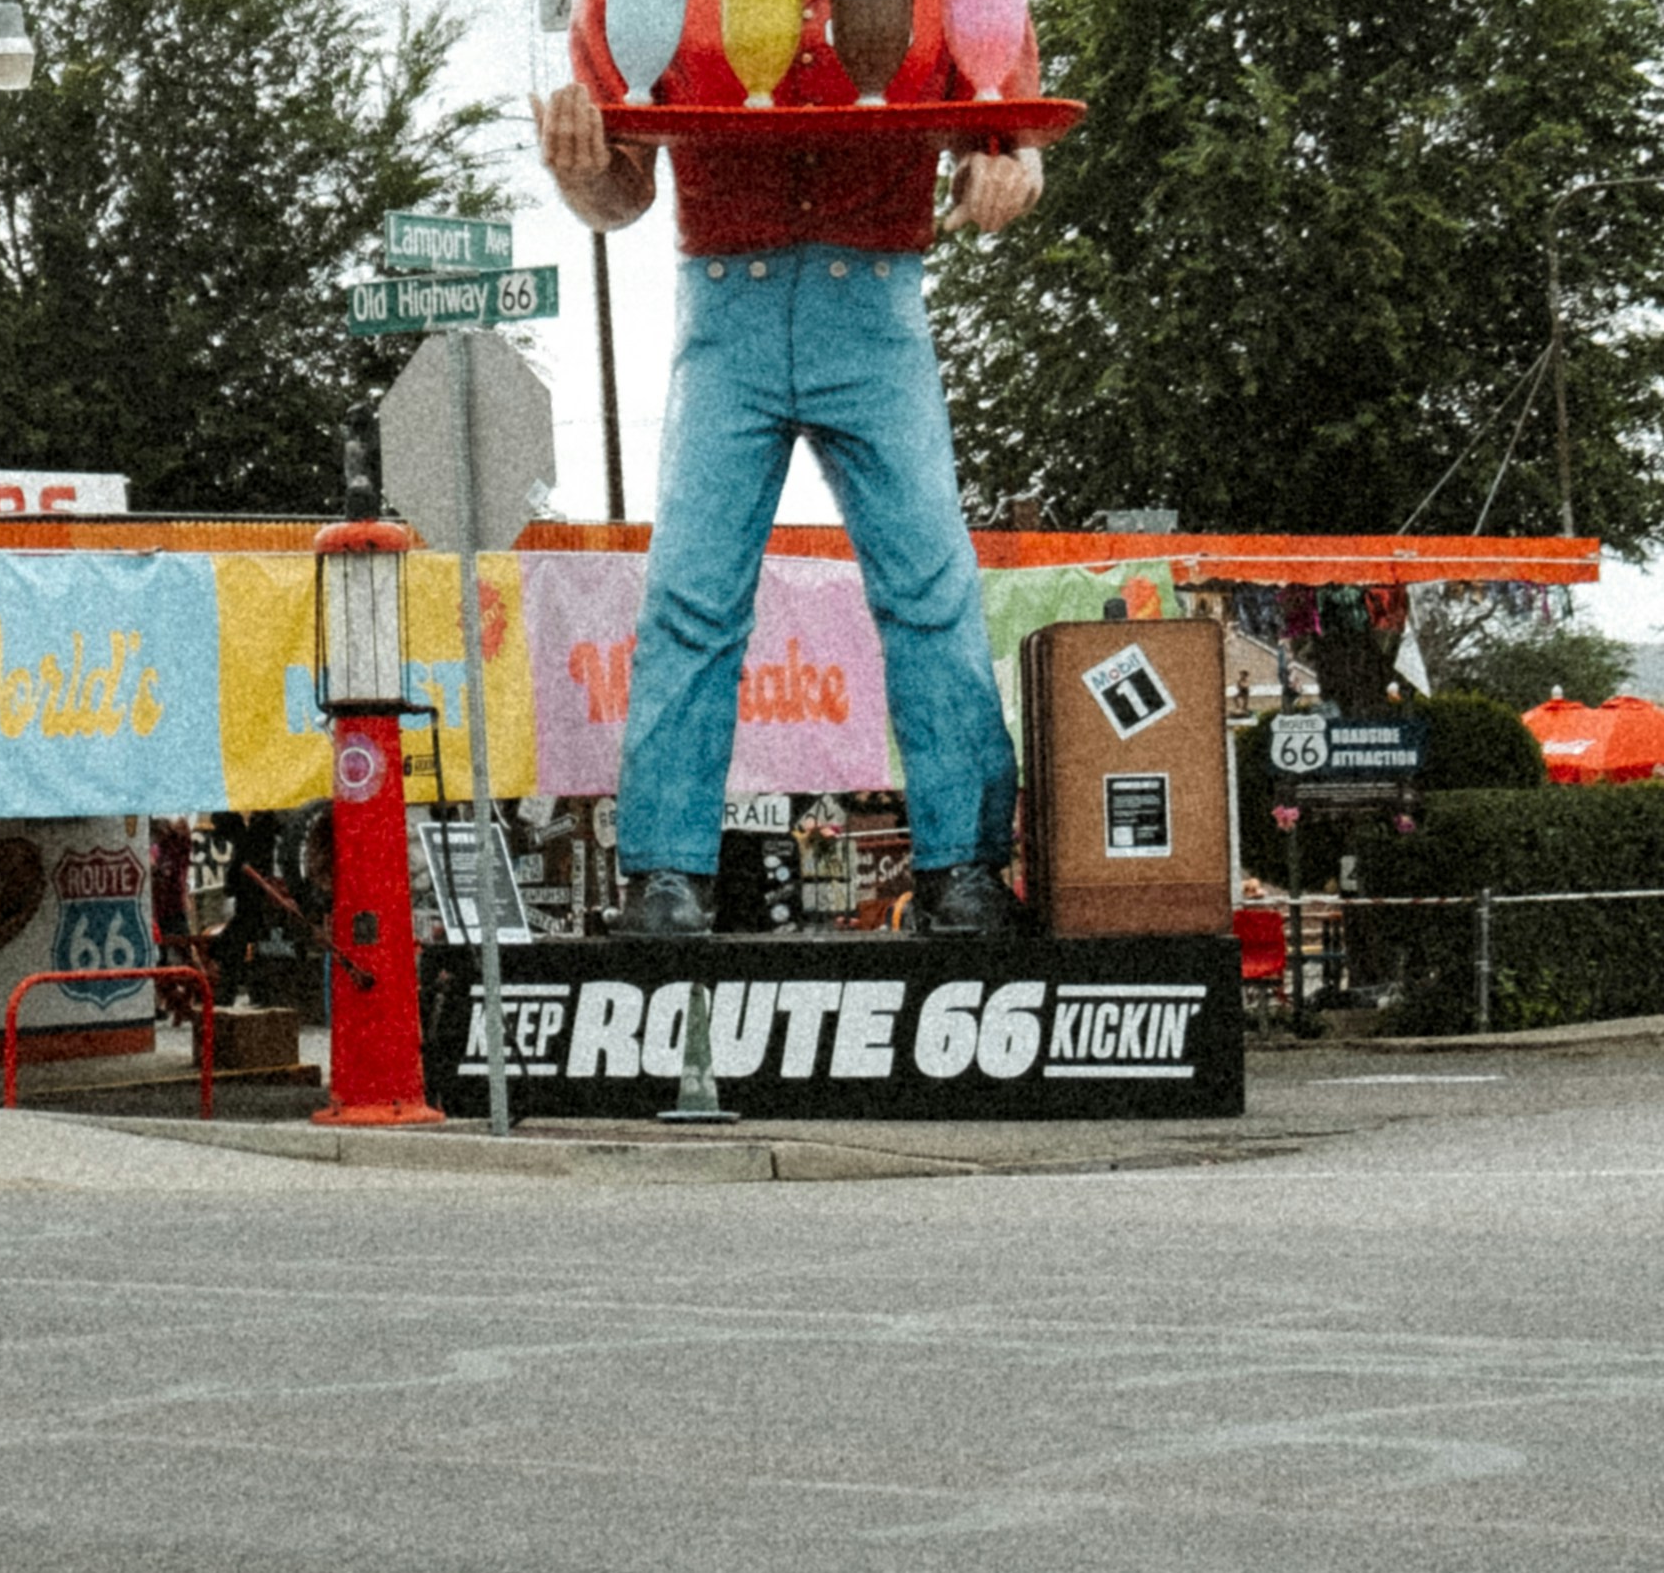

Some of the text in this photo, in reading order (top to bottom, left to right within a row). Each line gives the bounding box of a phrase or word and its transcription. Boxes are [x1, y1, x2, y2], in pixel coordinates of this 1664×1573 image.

[389, 215, 510, 261] Lamport Ave
[353, 284, 388, 322] Old
[397, 282, 488, 327] Highway
[501, 278, 532, 311] 66
[1091, 652, 1140, 690] Mobil
[284, 660, 468, 735] MST
[1115, 679, 1149, 717] 1
[1280, 735, 1319, 766] 66
[1330, 728, 1400, 744] ROADSIDE
[1331, 751, 1418, 767] ATTRACTION
[724, 803, 786, 826] RAIL
[68, 862, 134, 895] ROUTE
[69, 911, 135, 971] 66
[566, 980, 906, 1078] ROUTE
[913, 981, 1047, 1078] 66
[1048, 1002, 1201, 1059] KICKIN'
